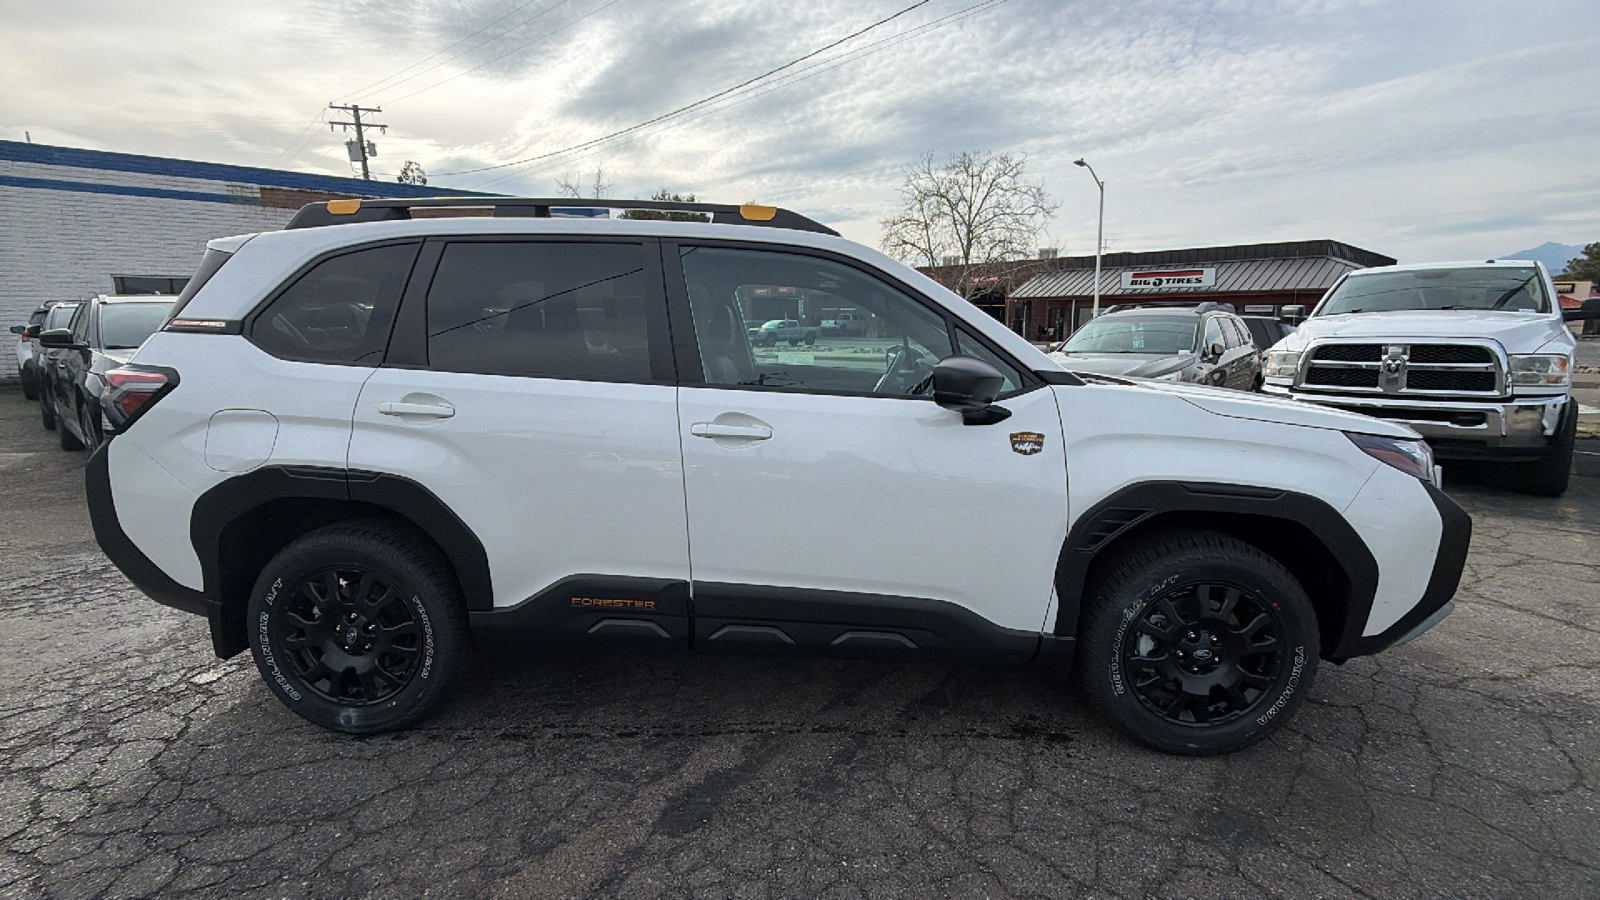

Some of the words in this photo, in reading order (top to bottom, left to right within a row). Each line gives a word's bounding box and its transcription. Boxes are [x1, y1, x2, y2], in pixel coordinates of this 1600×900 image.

[1165, 276, 1203, 285] TIRES
[571, 597, 656, 609] FORESTER
[1151, 574, 1180, 596] A/T
[260, 611, 302, 701] GEOLANDAR
[412, 595, 434, 679] YOKOHAMA
[1256, 645, 1304, 726] YOKOHAMA
